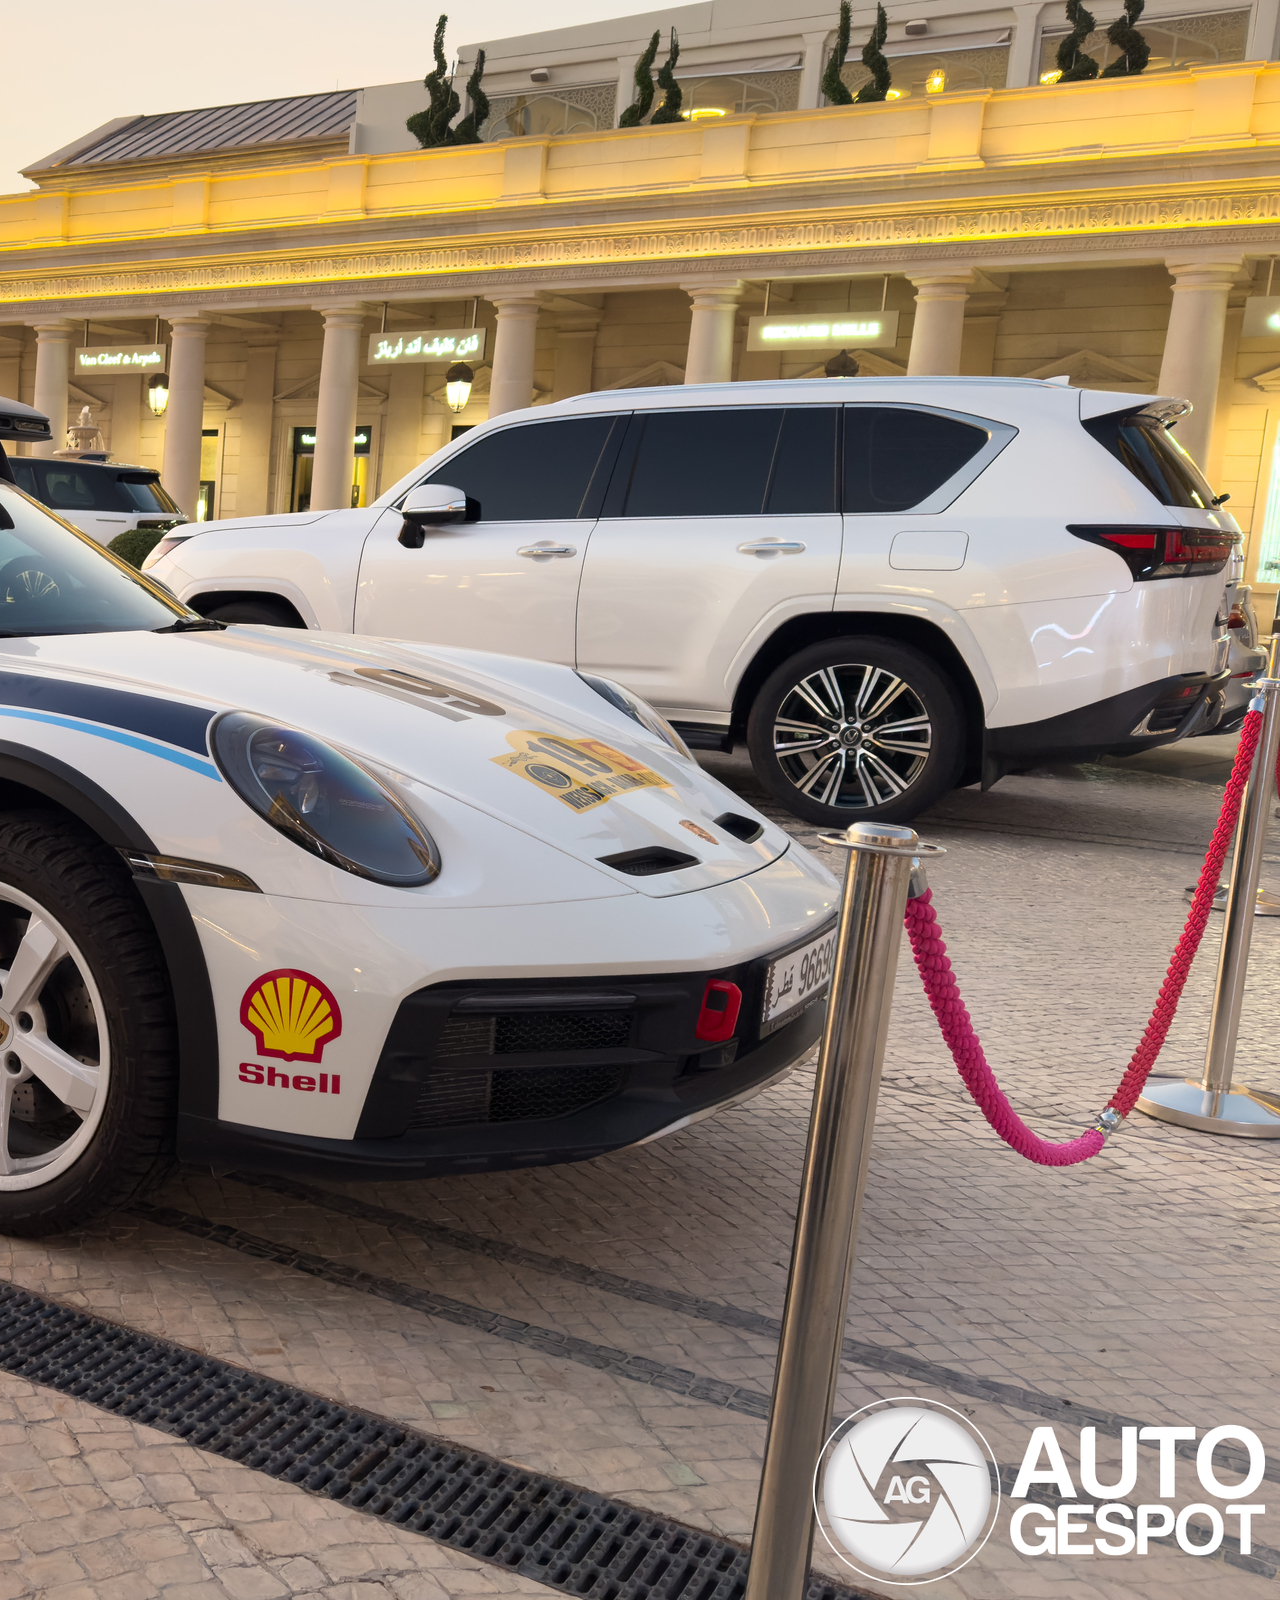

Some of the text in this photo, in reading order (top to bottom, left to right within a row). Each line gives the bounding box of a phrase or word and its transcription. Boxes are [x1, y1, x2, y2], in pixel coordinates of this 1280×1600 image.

[762, 322, 880, 339] RICHARD MILLE
[80, 351, 161, 367] Van Cleef & Arpels
[327, 667, 506, 722] 19
[526, 737, 613, 777] 19
[771, 964, 794, 1008] قطر
[238, 1062, 341, 1095] Shell
